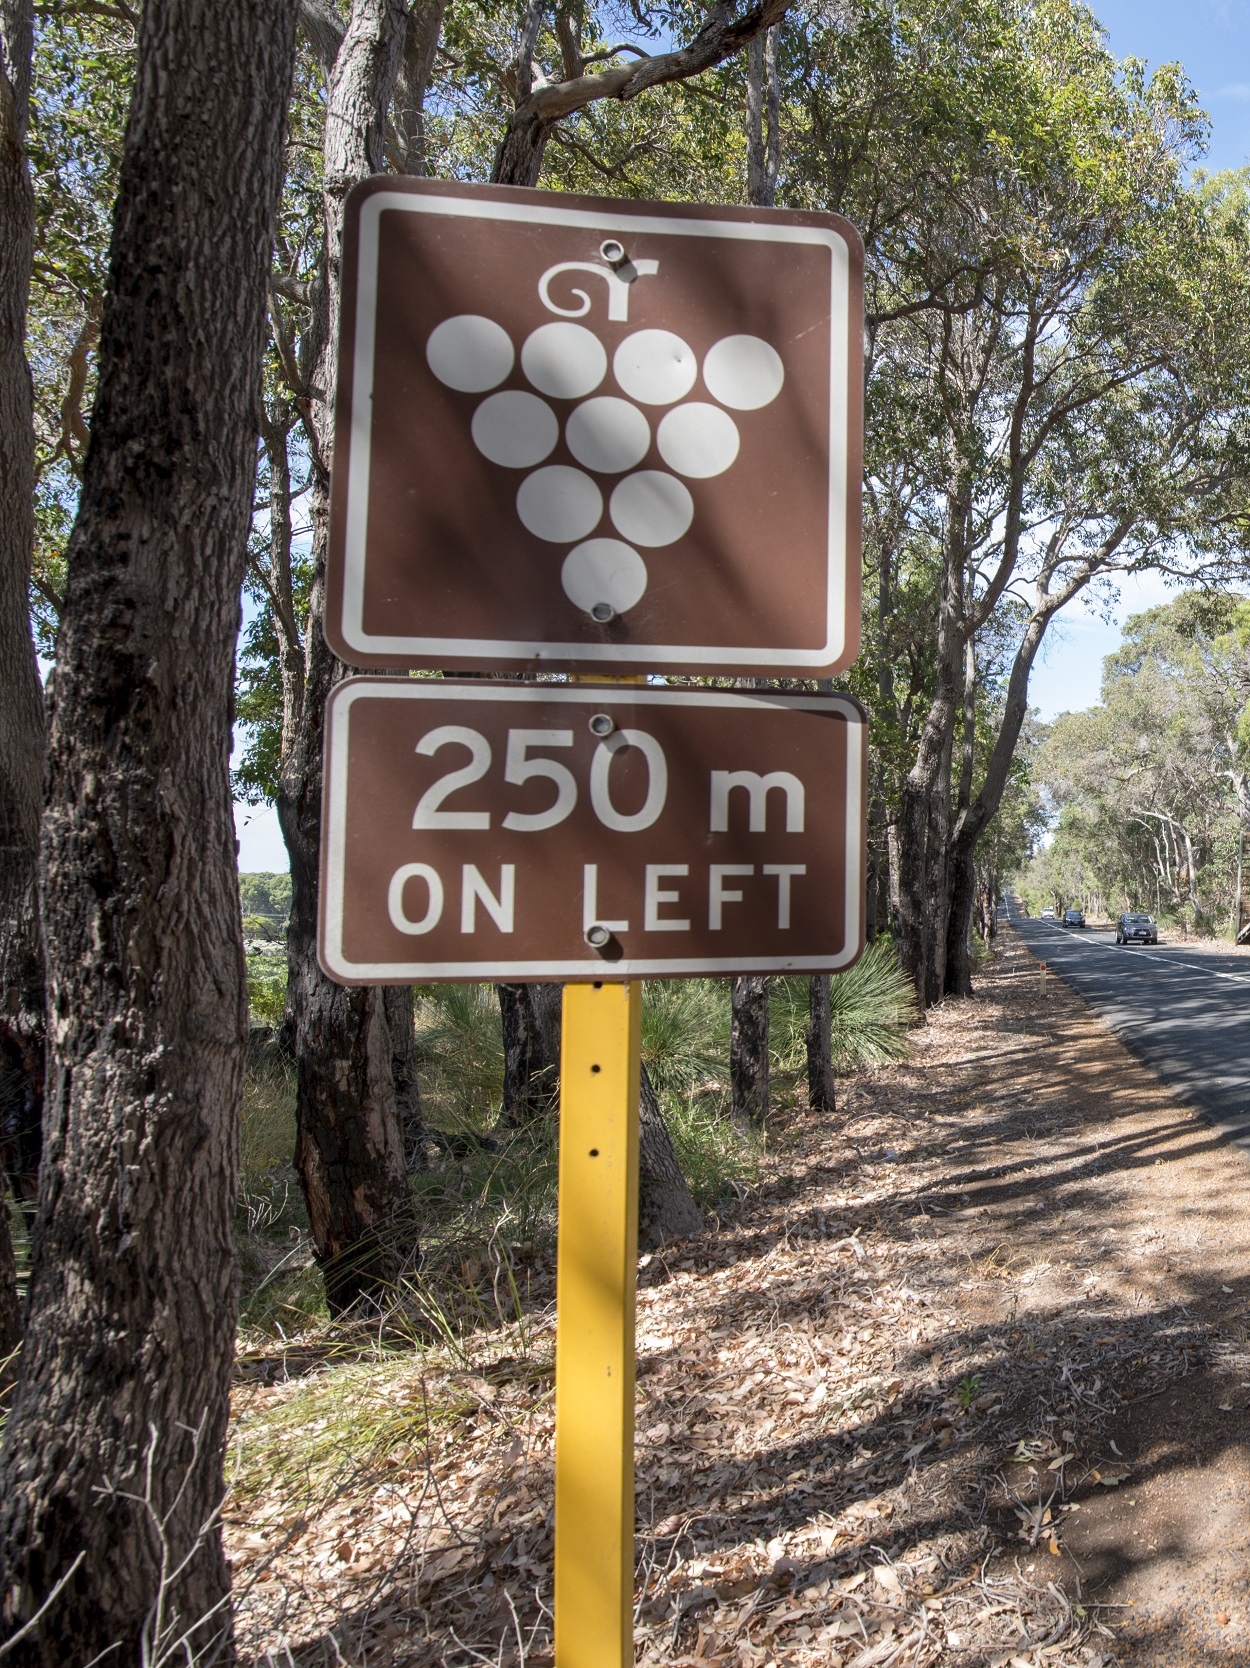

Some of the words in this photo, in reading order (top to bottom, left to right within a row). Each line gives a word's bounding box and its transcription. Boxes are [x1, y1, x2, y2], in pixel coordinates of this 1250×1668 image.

[412, 725, 668, 832] 250
[710, 770, 805, 833] m
[388, 862, 515, 935] ON
[583, 863, 806, 932] LEFT
